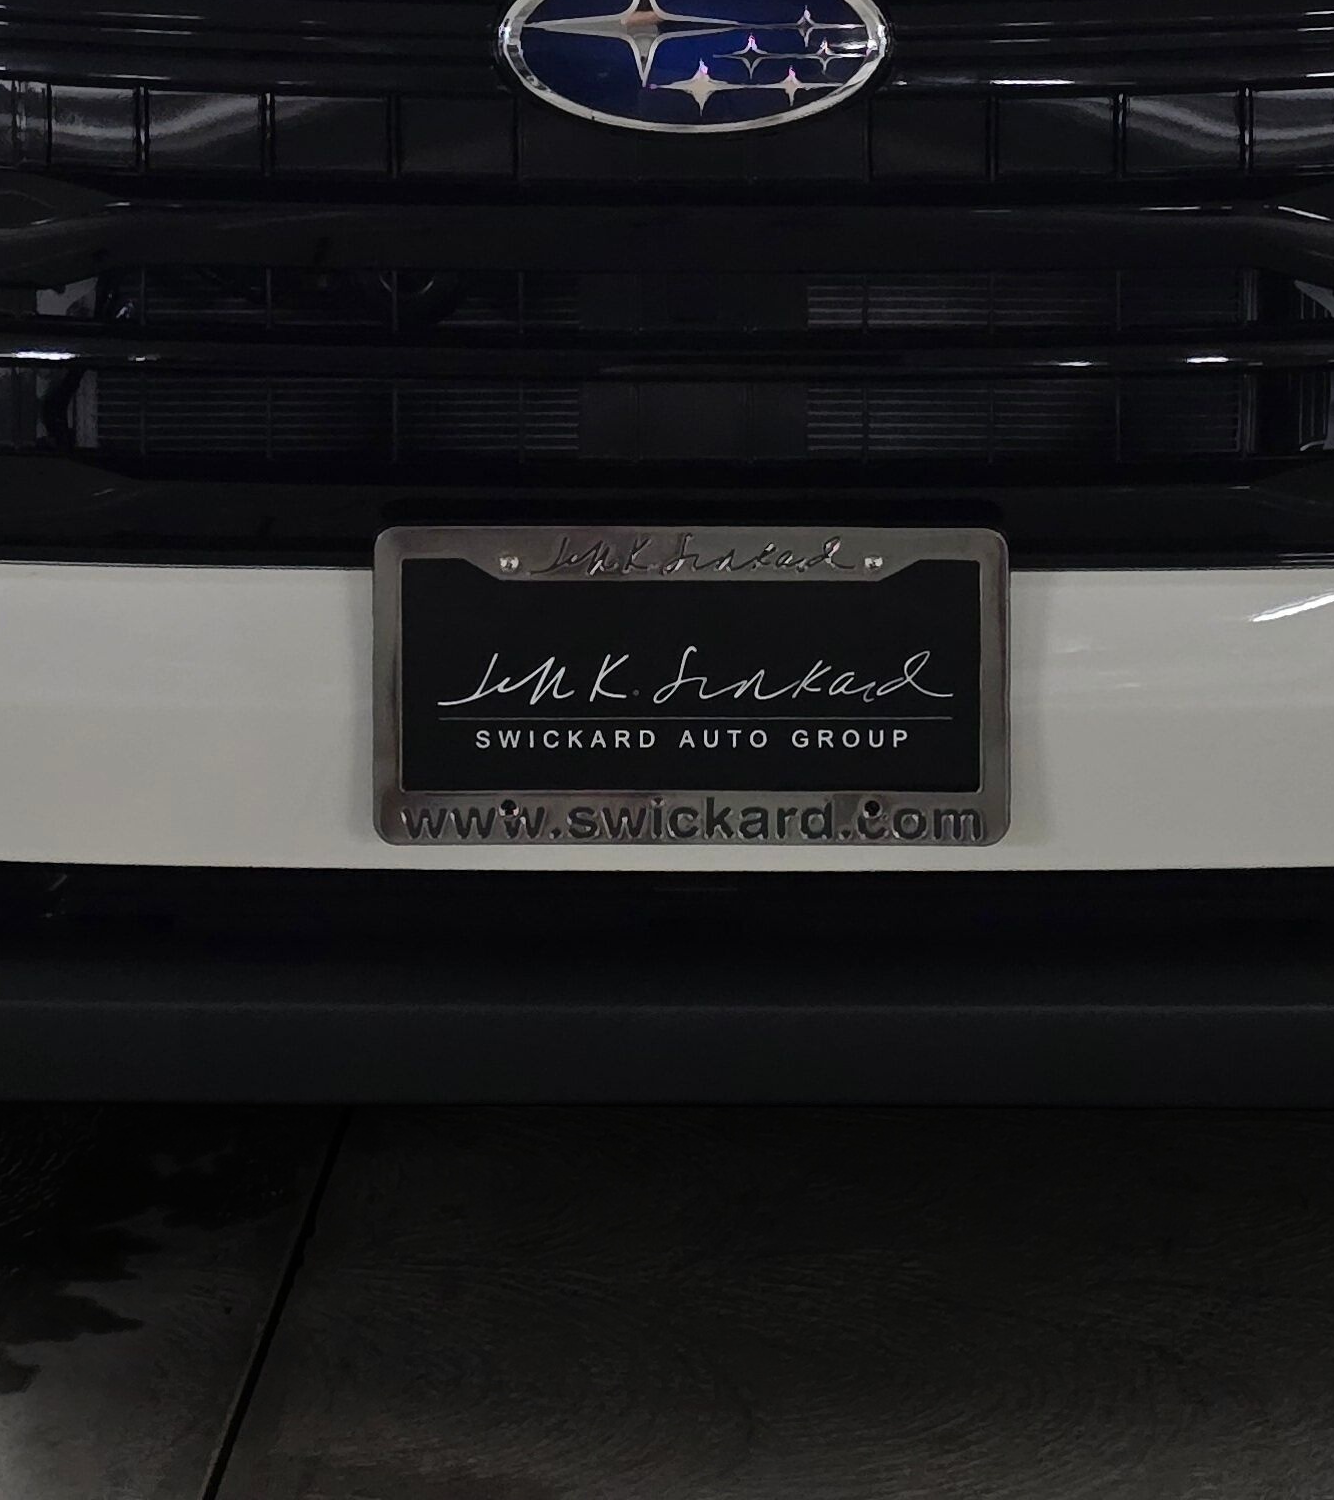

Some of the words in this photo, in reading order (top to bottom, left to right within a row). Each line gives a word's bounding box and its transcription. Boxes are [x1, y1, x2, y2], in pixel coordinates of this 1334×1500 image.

[475, 729, 657, 750] SWICKARD
[679, 729, 769, 750] AUTO
[791, 729, 911, 750] GROUP
[400, 796, 984, 840] www.swickard.com
